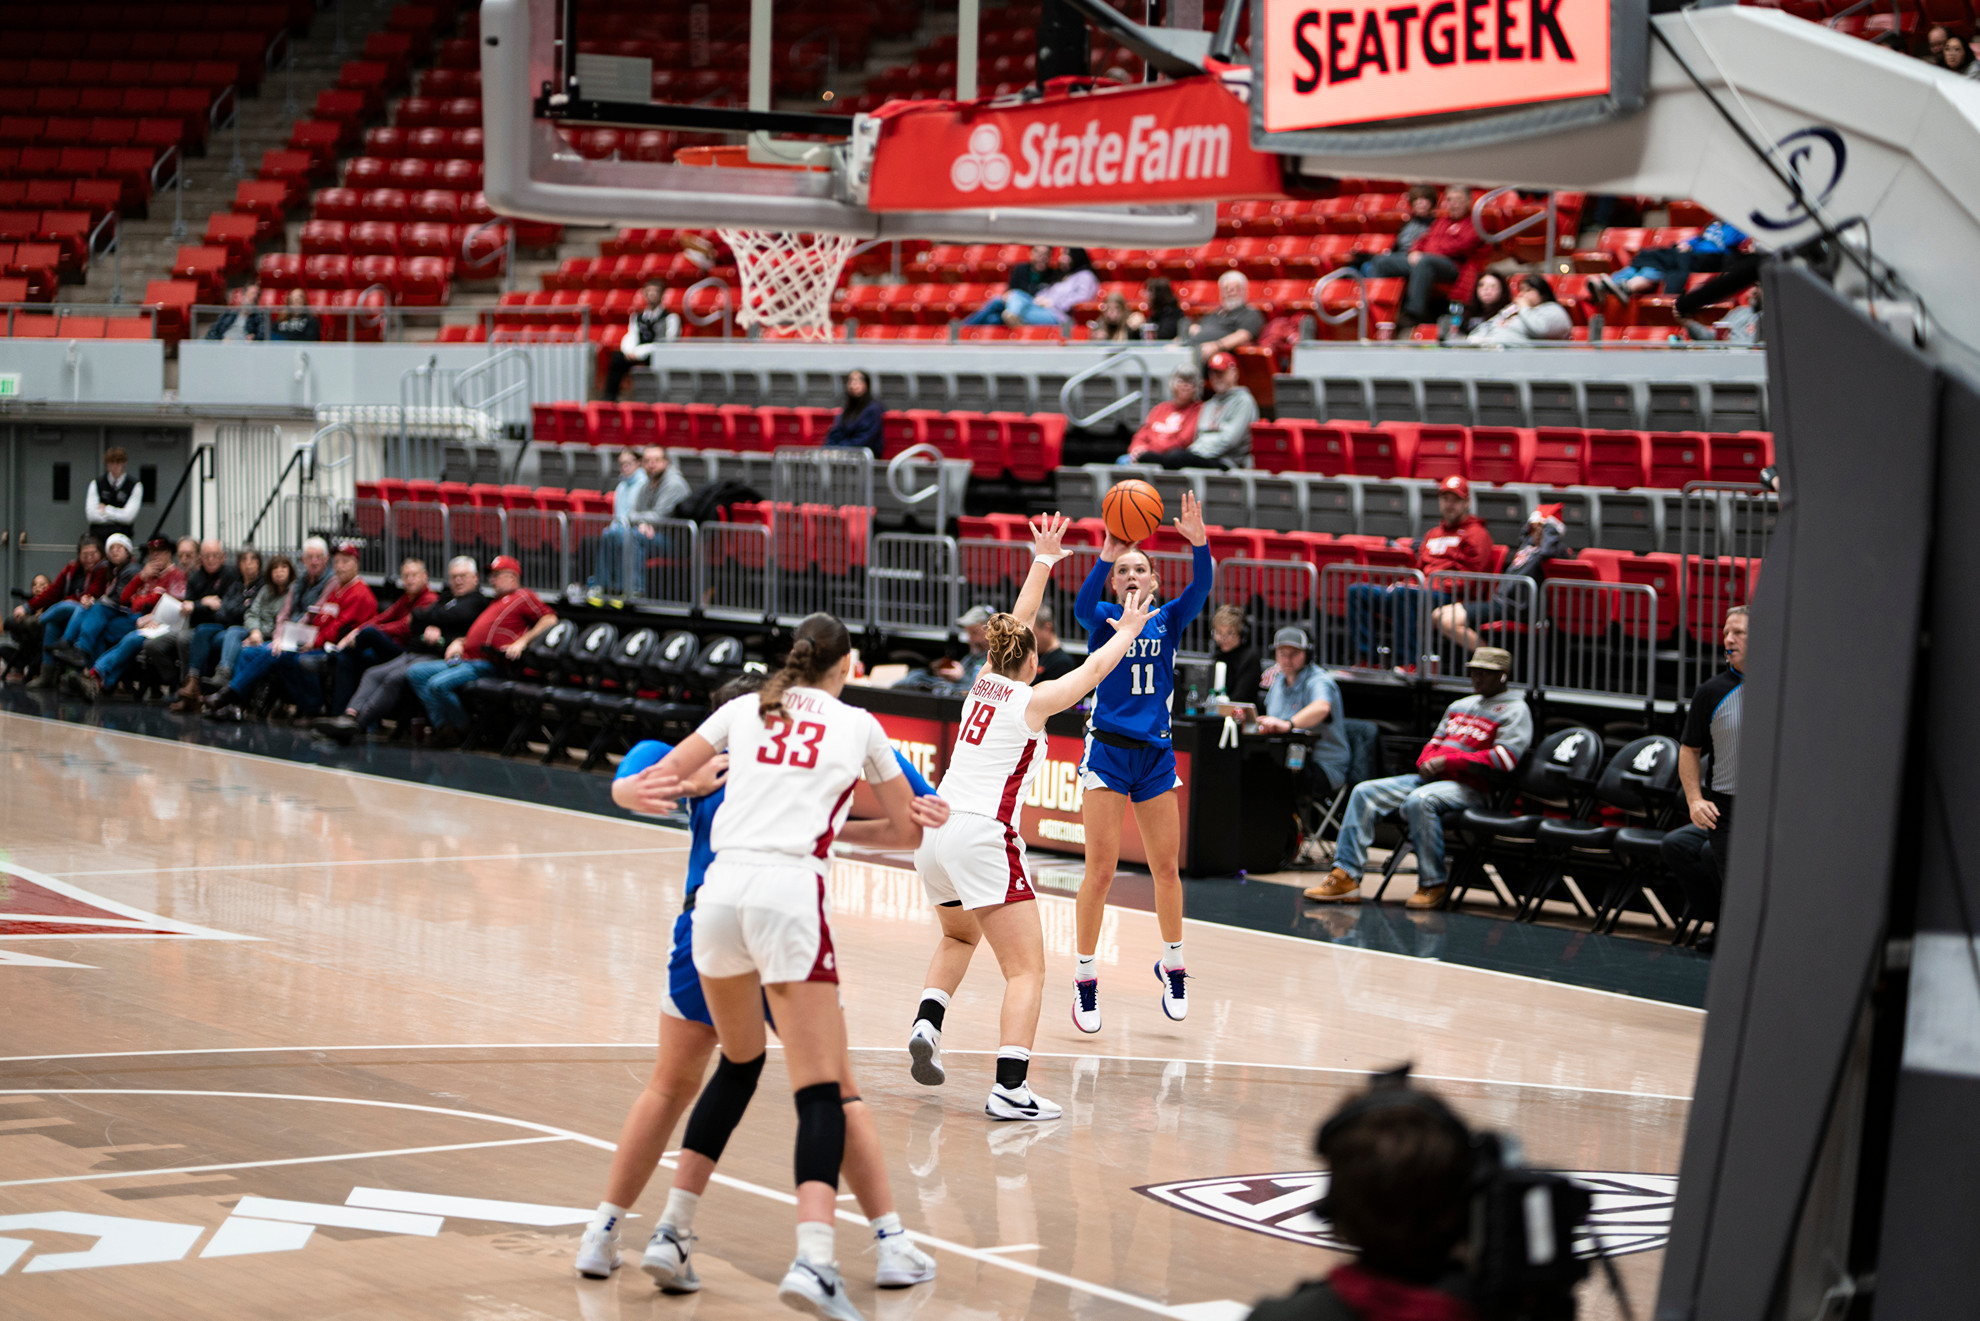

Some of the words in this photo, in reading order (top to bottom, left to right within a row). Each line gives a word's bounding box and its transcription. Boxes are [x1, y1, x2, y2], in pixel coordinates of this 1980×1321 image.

[1293, 0, 1576, 95] SEATGEEK
[970, 678, 1014, 703] ABRAHAM
[1130, 663, 1156, 696] 11
[784, 691, 825, 716] OVILL
[959, 700, 997, 746] 19
[756, 714, 827, 770] 33
